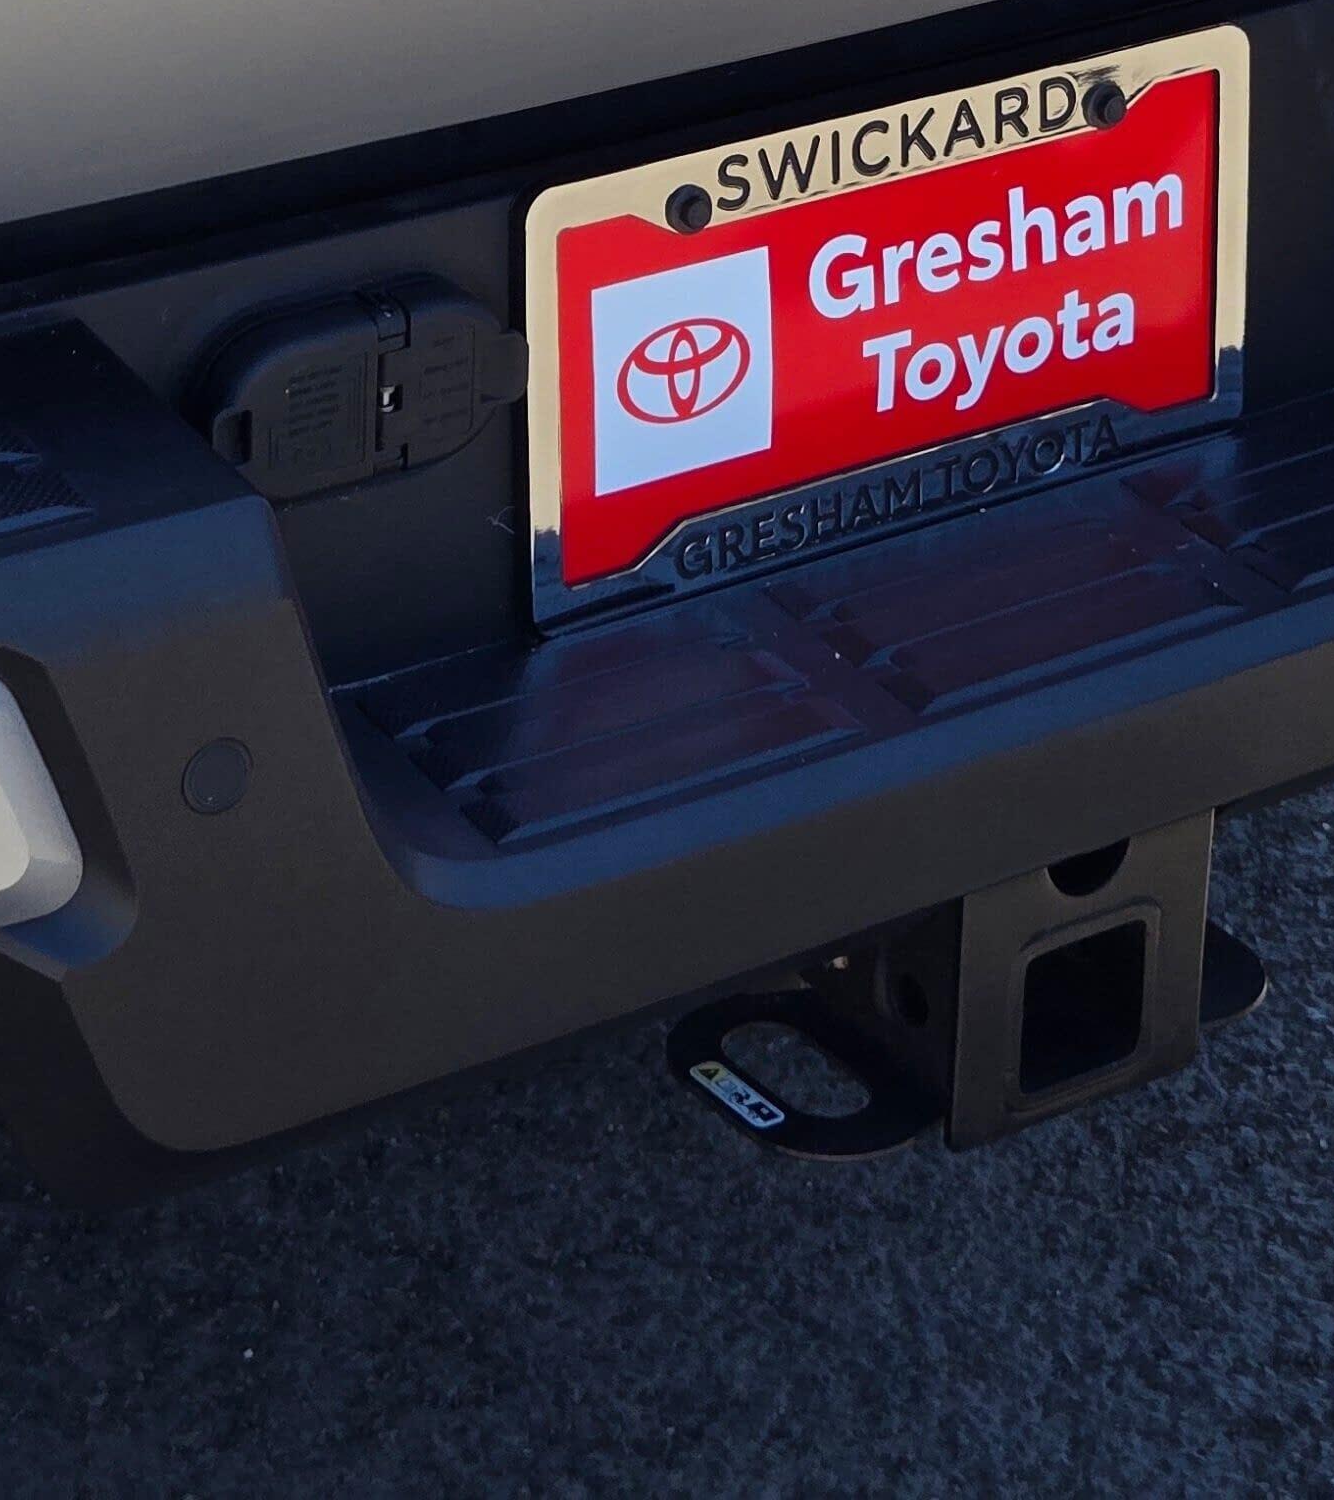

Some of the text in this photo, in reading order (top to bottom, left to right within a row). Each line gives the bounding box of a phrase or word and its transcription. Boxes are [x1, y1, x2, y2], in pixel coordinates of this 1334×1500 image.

[717, 75, 1079, 212] SWICKARD
[809, 173, 1184, 319] Gresham
[862, 289, 1135, 413] Toyota
[673, 412, 1123, 581] GRESHAM TOYOTA
